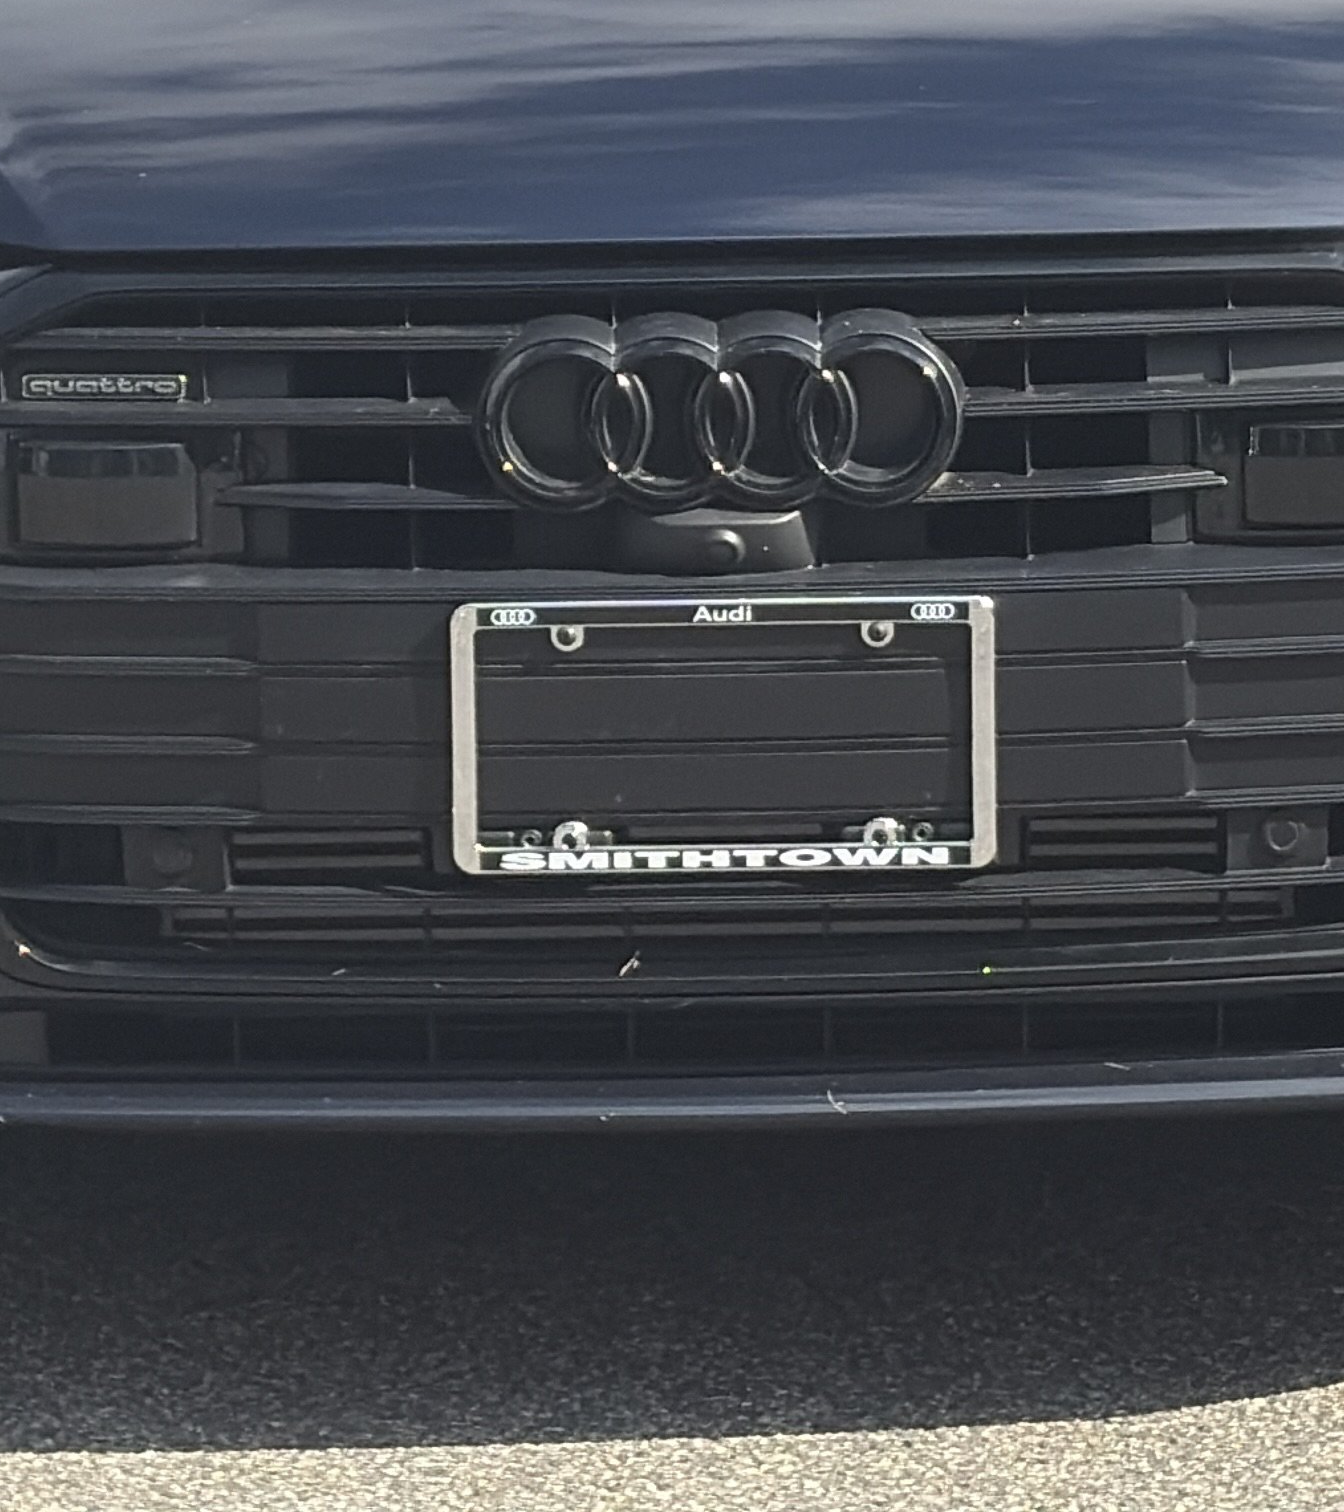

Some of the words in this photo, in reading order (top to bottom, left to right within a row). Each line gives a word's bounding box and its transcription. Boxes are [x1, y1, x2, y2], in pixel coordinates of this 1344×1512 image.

[29, 376, 177, 396] quattro
[692, 604, 753, 623] Audi
[499, 847, 950, 871] SMITHTOWN
